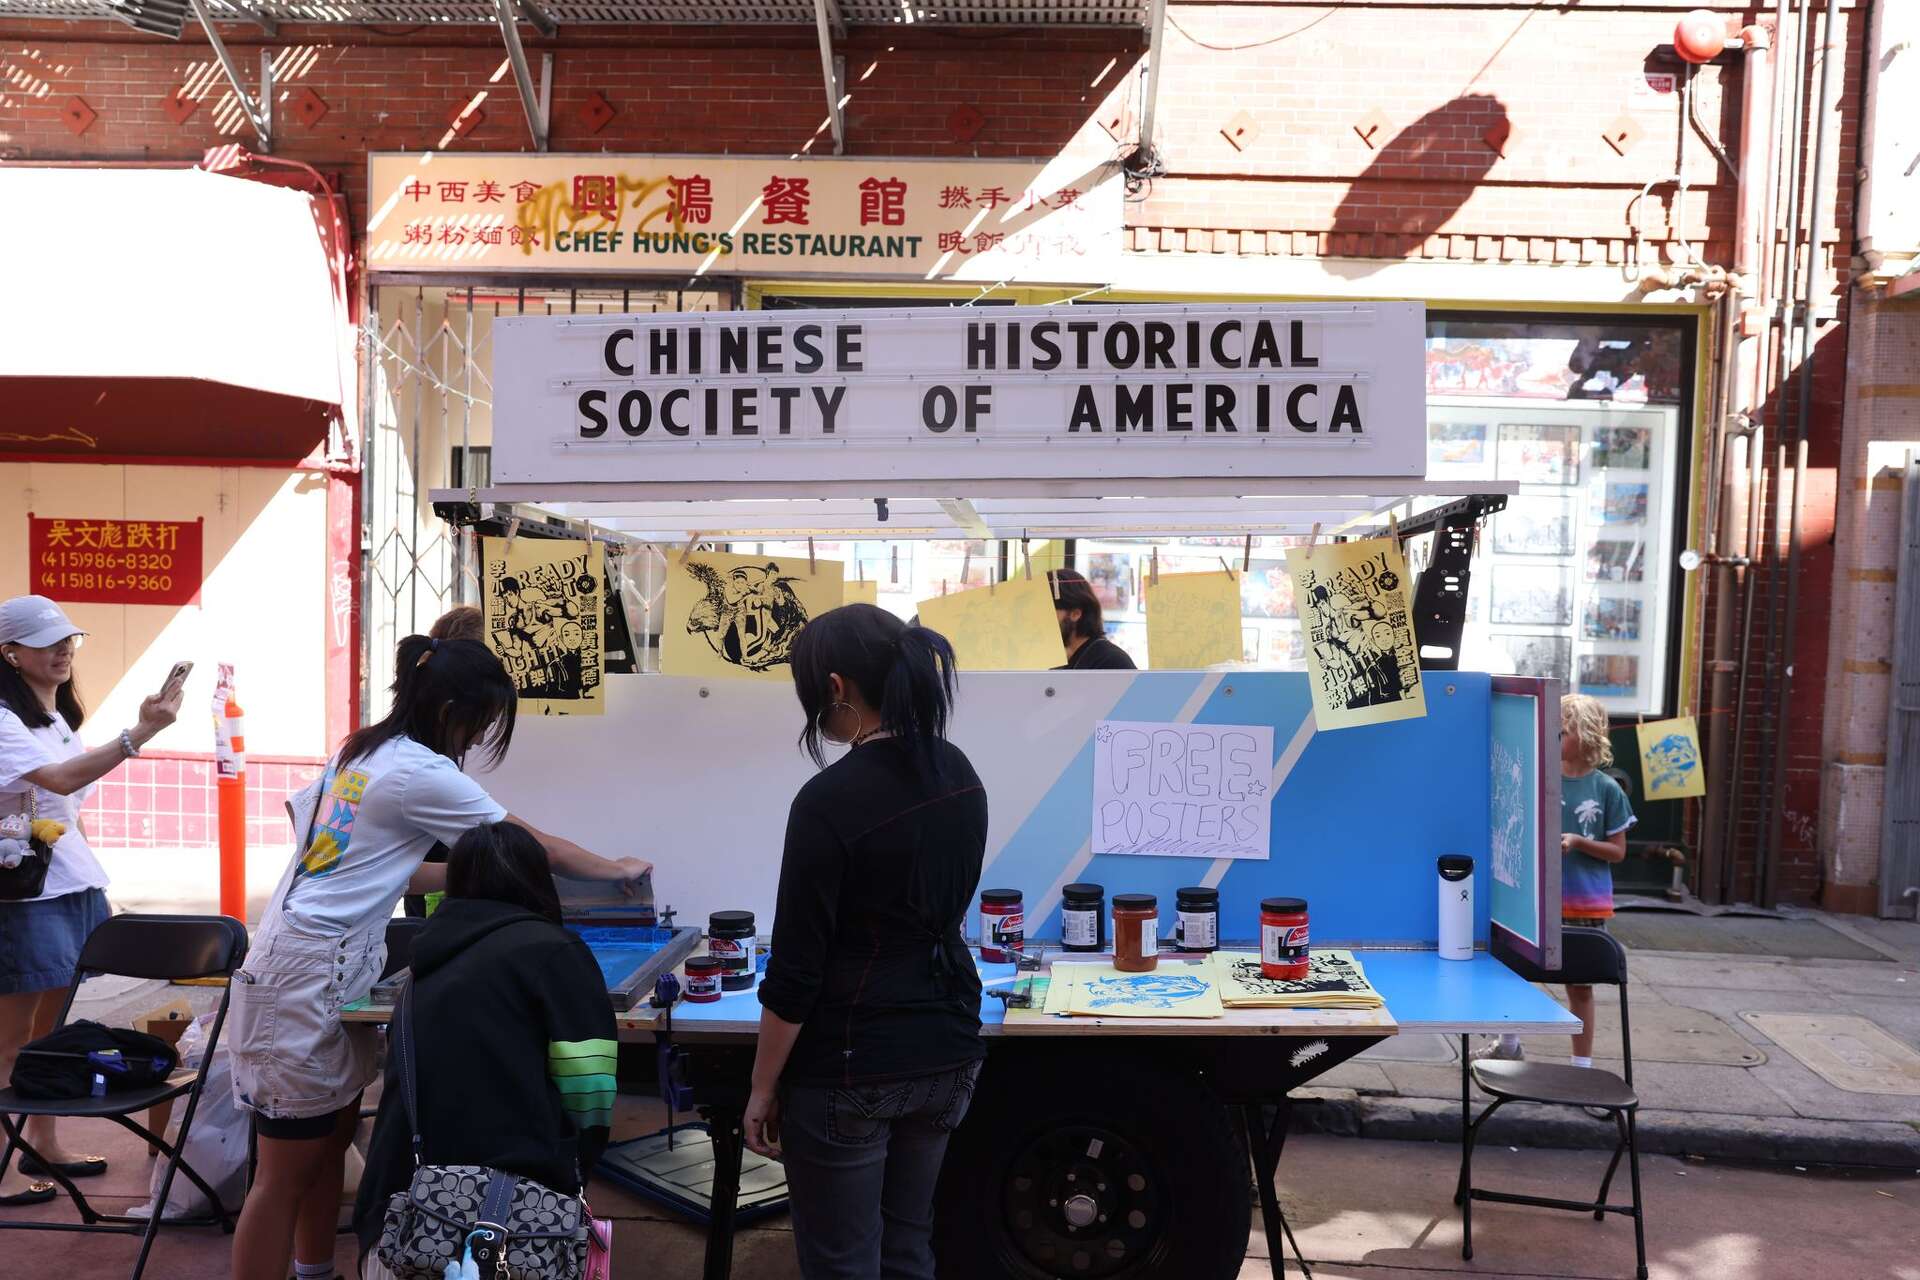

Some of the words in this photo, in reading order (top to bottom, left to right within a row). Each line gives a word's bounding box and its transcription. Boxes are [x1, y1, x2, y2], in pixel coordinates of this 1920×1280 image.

[403, 180, 543, 203] 中西美食
[555, 230, 623, 253] CHEF
[633, 231, 733, 255] HUNG'S
[742, 232, 922, 258] RESTAURANT
[604, 324, 863, 376] CHINESE
[966, 319, 1319, 371] HISTORICAL
[577, 385, 847, 439] SOCIETY
[921, 384, 992, 434] OF
[1067, 383, 1364, 434] AMERICA
[41, 552, 172, 570] (415)986-8320
[516, 555, 588, 590] READY
[1326, 552, 1389, 597] READY
[41, 573, 172, 591] (415)816-9360
[580, 618, 597, 626] KIM
[1389, 614, 1407, 625] KIM
[1312, 633, 1325, 643] LEE
[1111, 729, 1257, 801] FREE
[1101, 799, 1260, 844] POSTERS
